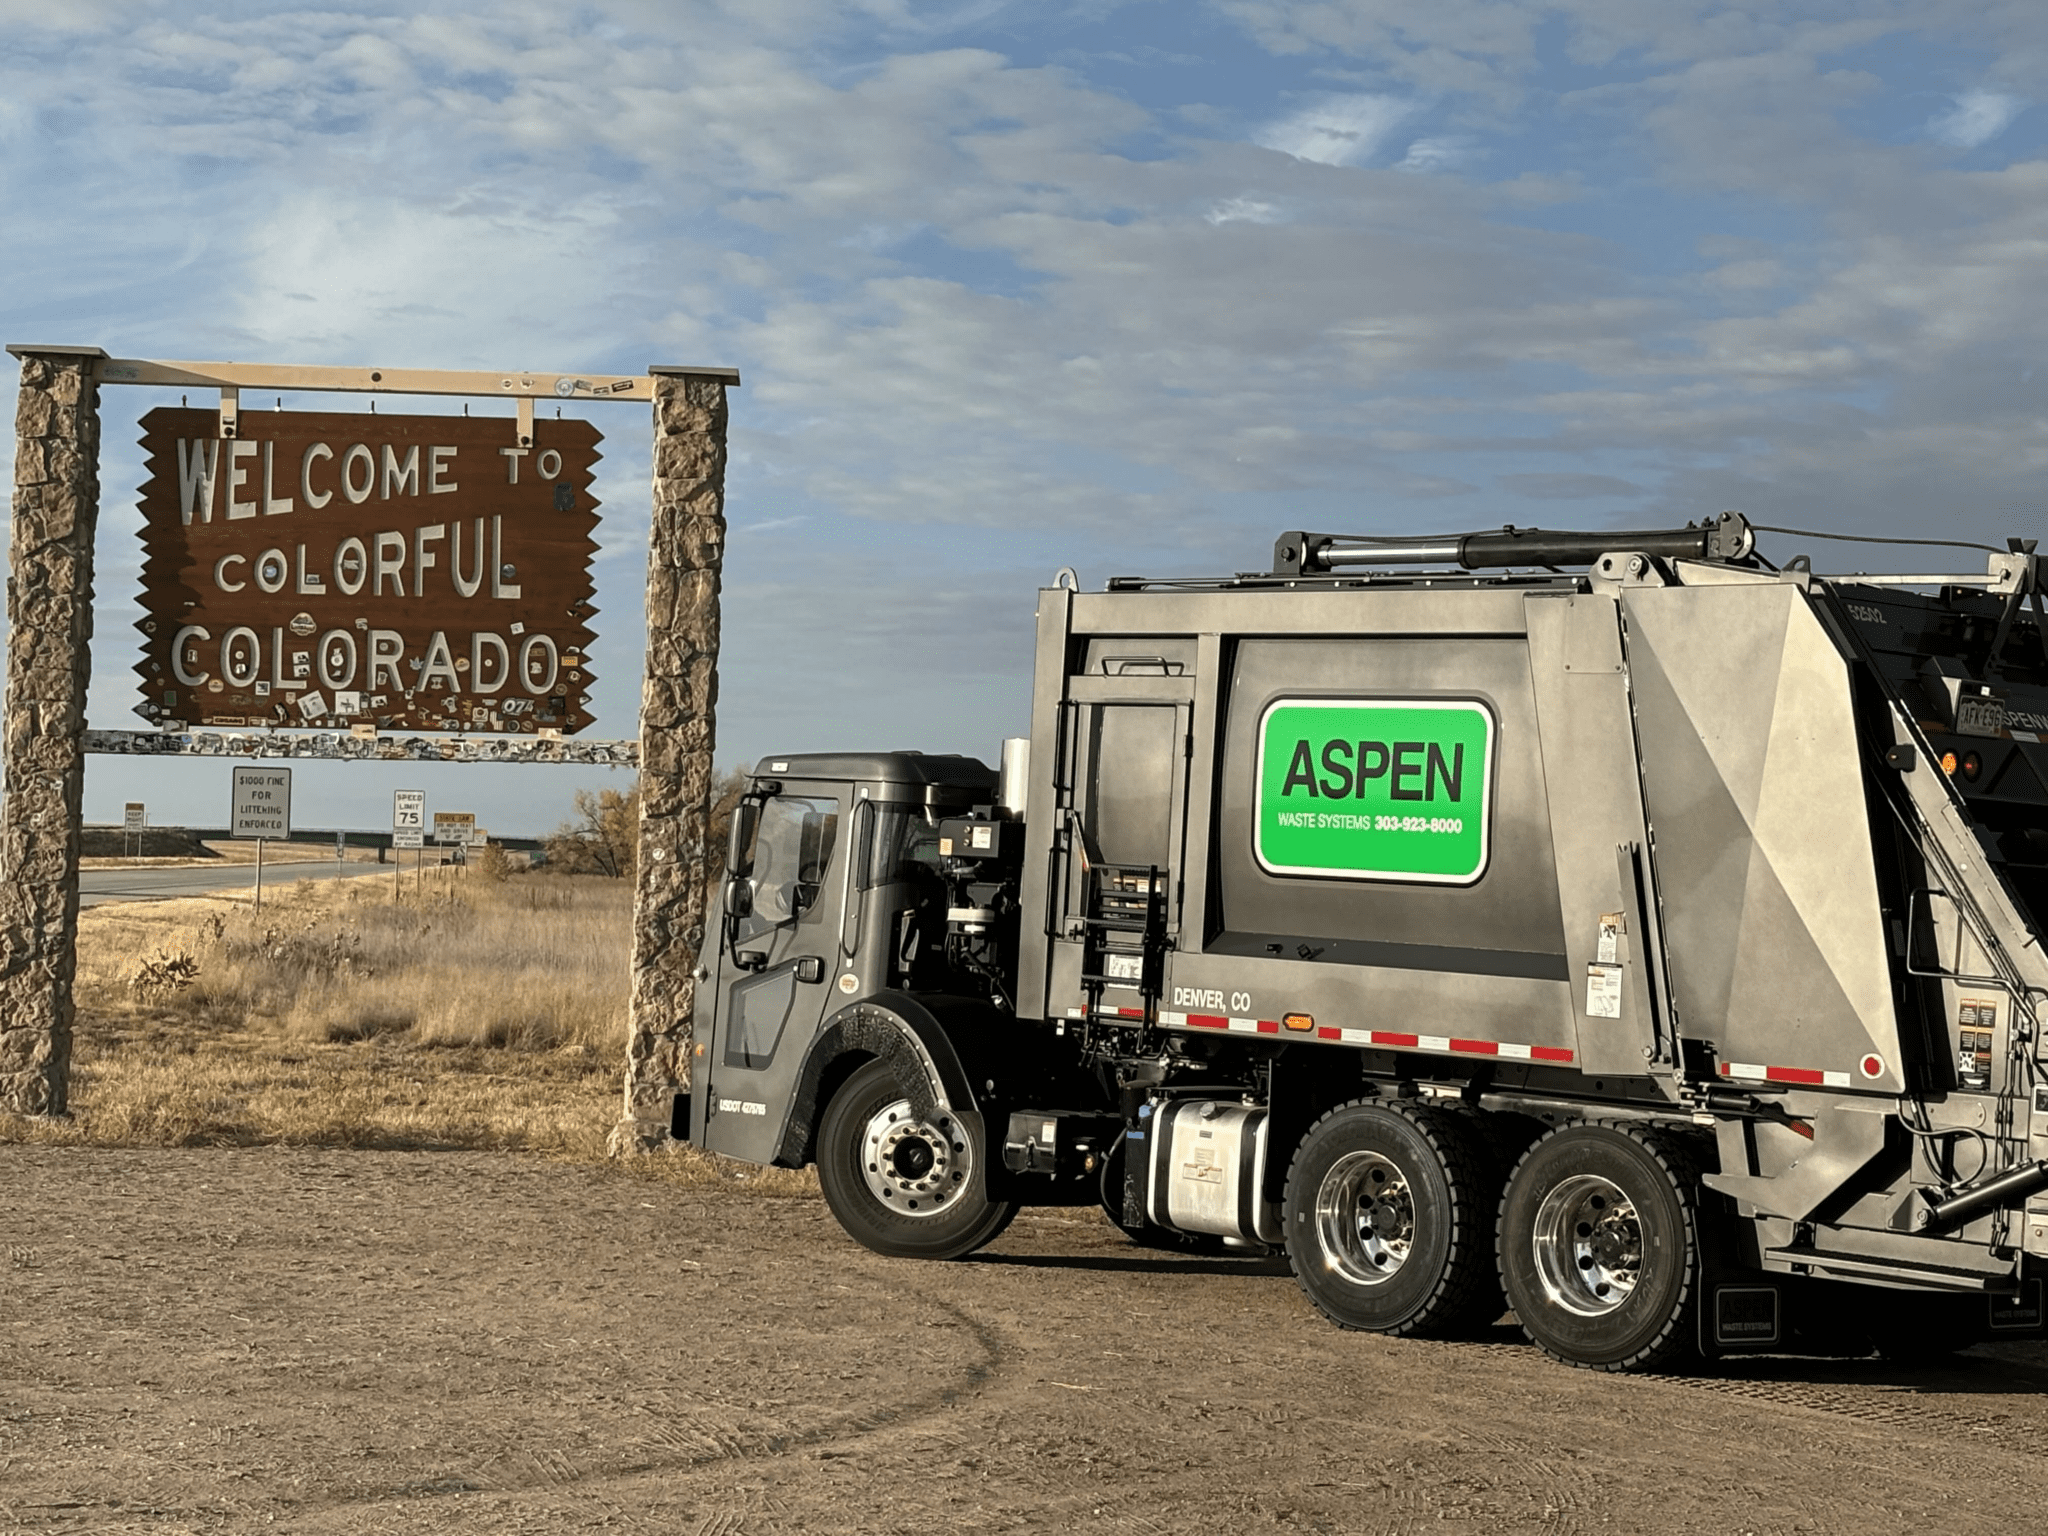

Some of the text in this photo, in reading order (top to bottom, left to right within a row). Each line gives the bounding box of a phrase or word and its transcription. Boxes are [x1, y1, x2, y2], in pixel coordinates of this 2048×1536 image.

[177, 437, 562, 525] WELCOME TO
[214, 514, 521, 600] COLORFUL
[1847, 604, 1887, 624] 52502
[171, 624, 558, 695] COLORADO
[1281, 738, 1464, 803] ASPEN
[239, 776, 285, 786] $1000 FINE
[251, 791, 271, 800] FOR
[240, 805, 282, 815] LITTERING
[399, 812, 419, 824] 75
[239, 819, 282, 829] ENFORCED
[1278, 812, 1462, 834] WASTE SYSTEMS 303-923-8000
[1174, 987, 1251, 1013] DENVER, CO
[720, 1099, 742, 1112] USDOT
